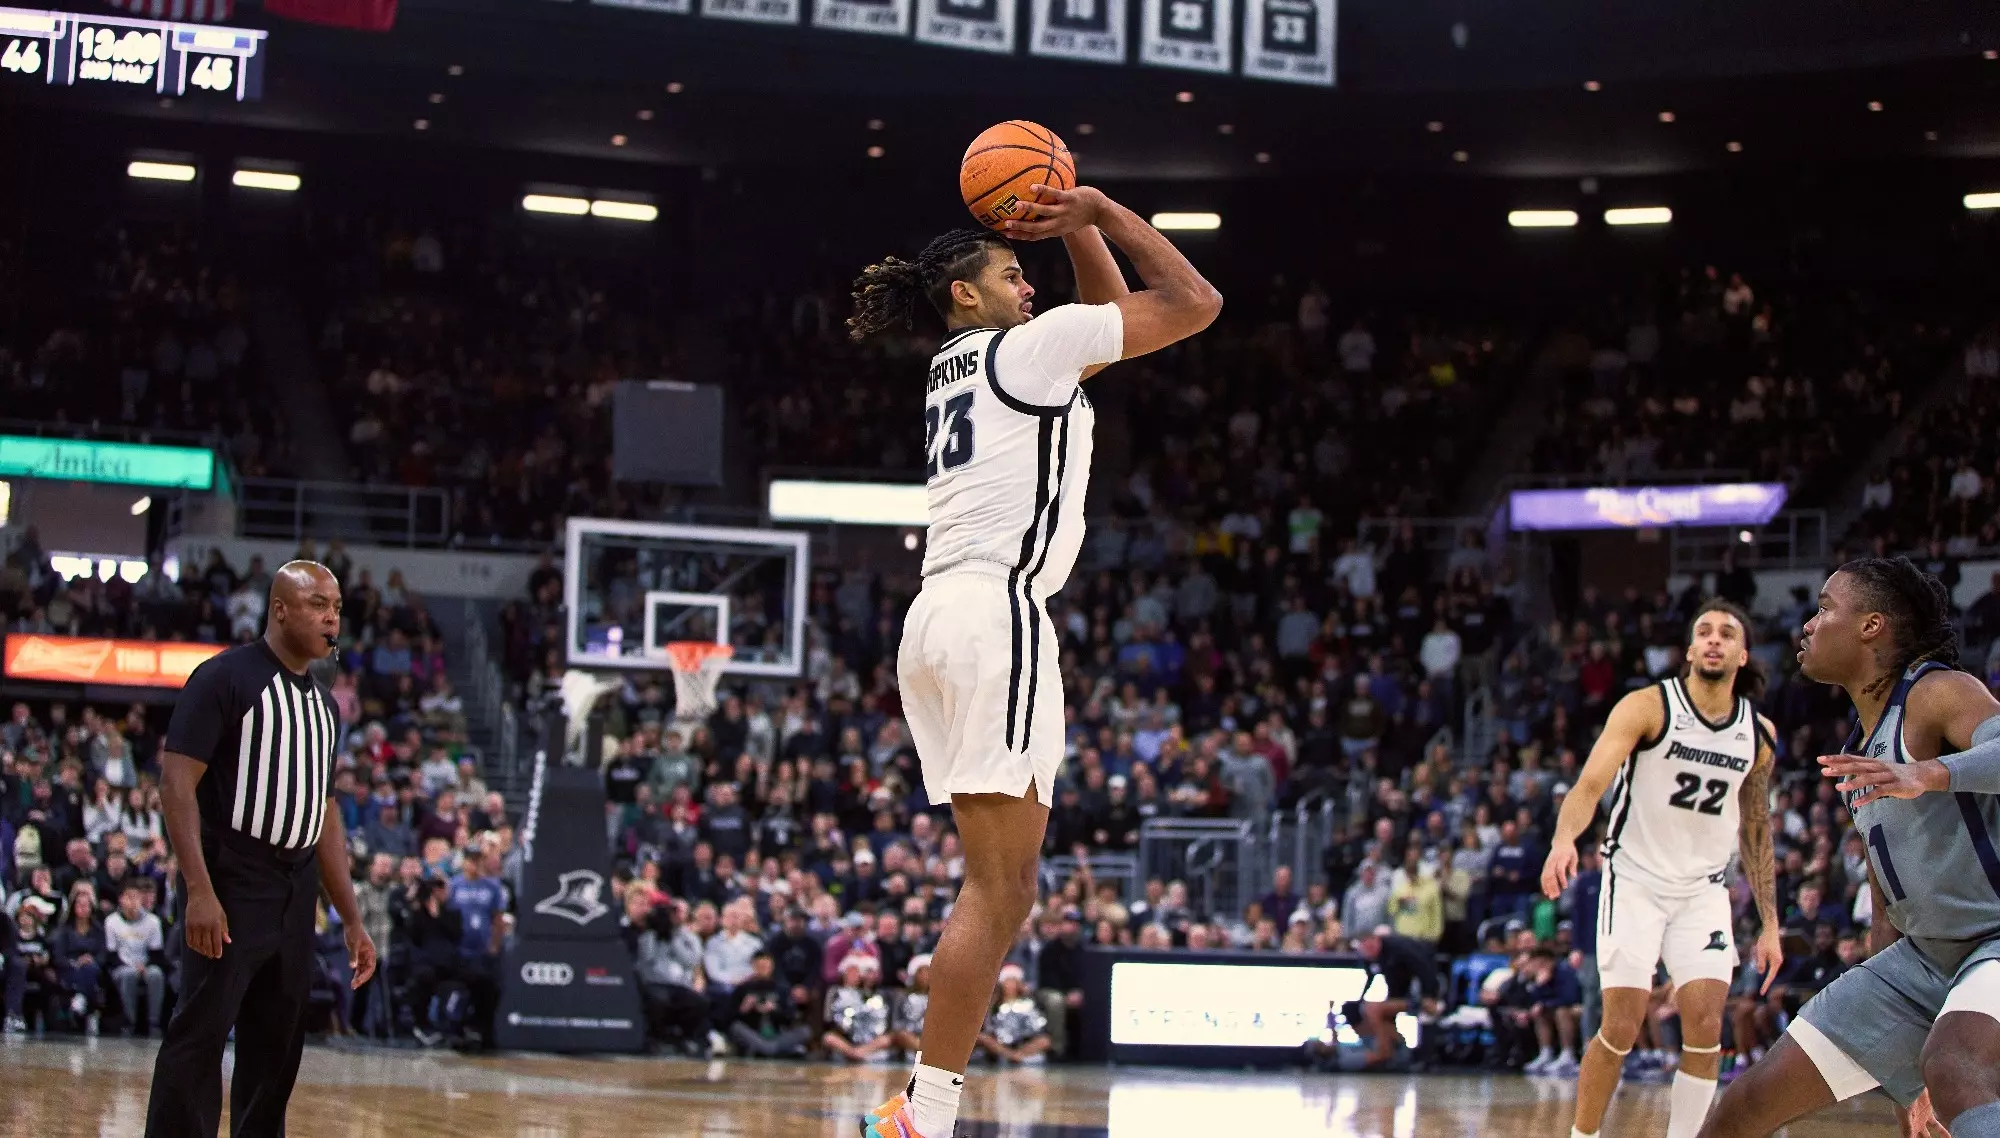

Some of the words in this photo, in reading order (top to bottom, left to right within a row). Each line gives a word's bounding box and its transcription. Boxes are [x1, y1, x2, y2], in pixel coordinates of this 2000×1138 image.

[1272, 14, 1306, 43] 33
[1, 39, 41, 73] 46
[1664, 740, 1749, 773] PROVIDENCE
[1669, 771, 1729, 815] 22
